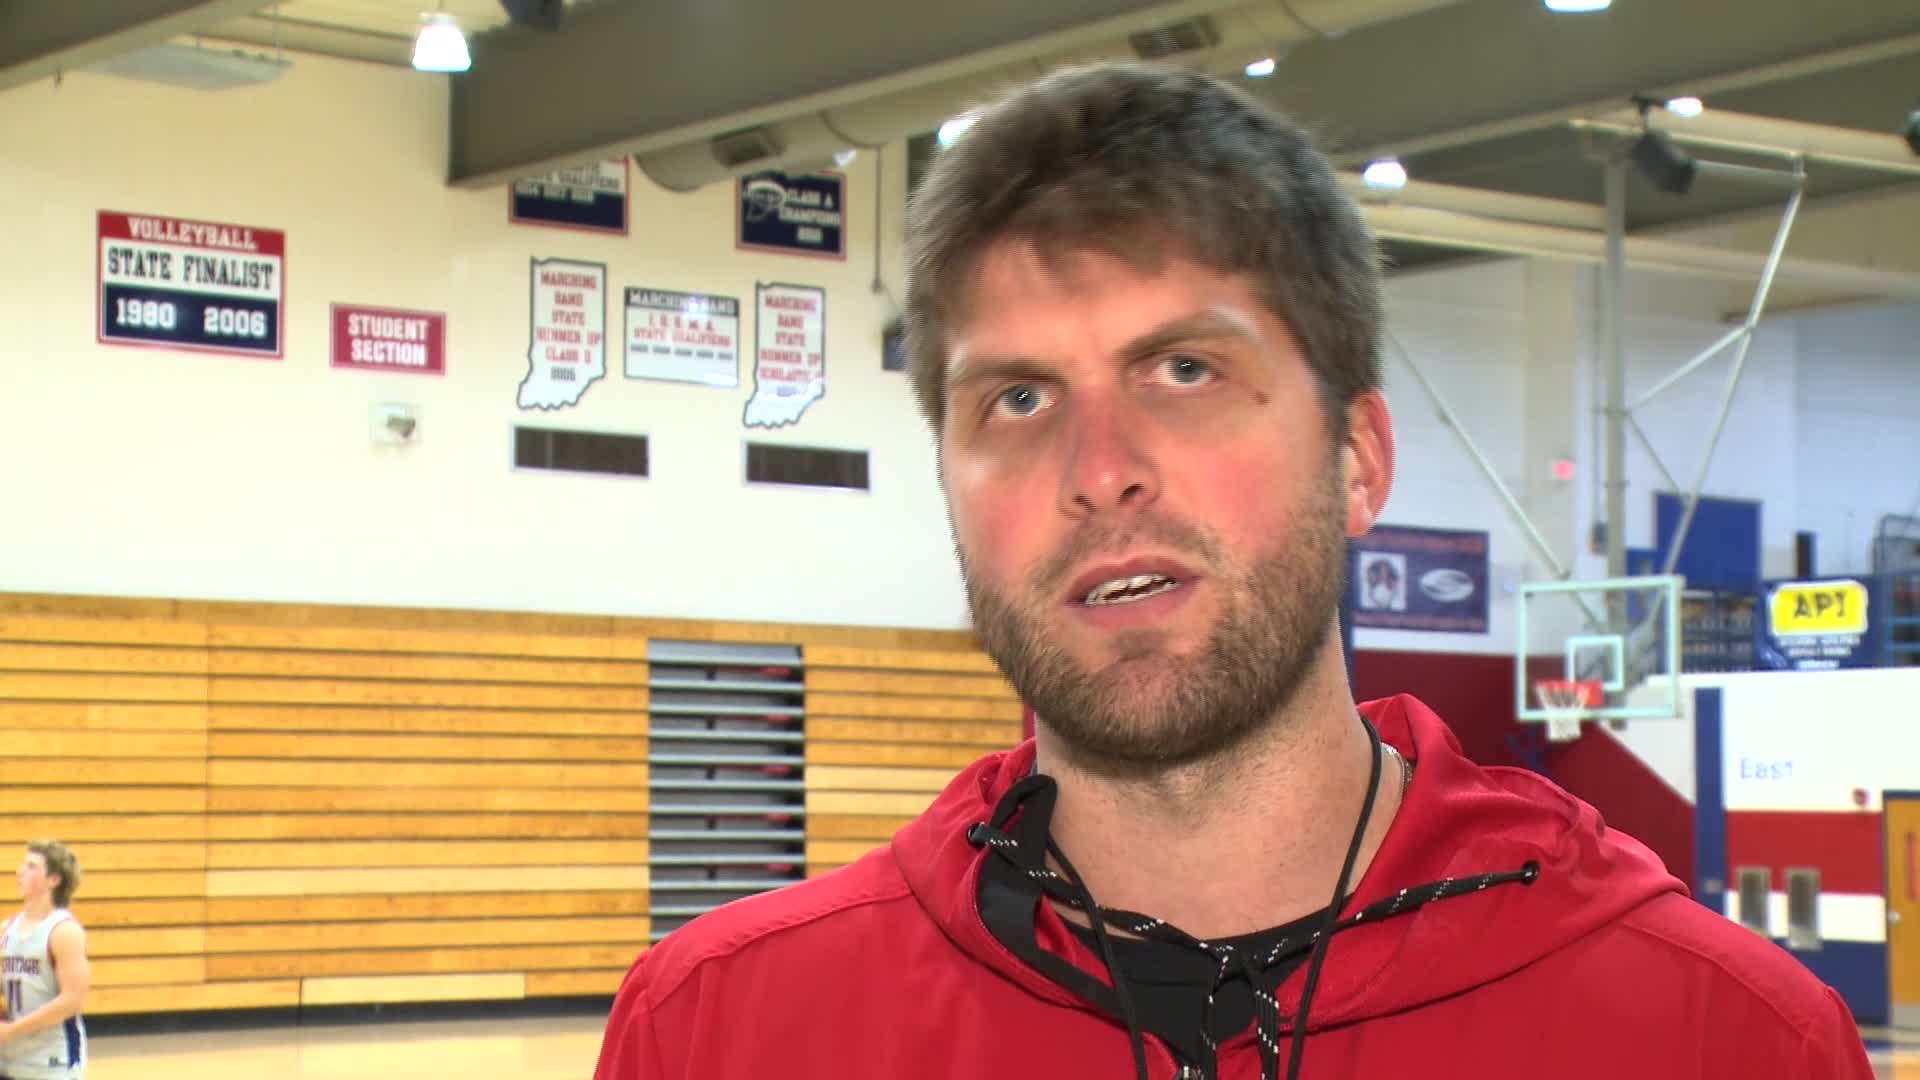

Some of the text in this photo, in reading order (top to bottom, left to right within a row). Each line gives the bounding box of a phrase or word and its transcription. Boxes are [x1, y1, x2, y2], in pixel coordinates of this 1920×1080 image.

[127, 216, 257, 250] VOLLEYBALL
[108, 247, 273, 289] STATE FINALIST
[541, 271, 598, 289] MARCHING
[554, 291, 583, 306] BAND
[116, 297, 268, 339] 1980 2006
[347, 313, 428, 341] STUDENT
[551, 309, 585, 326] STATE
[351, 338, 427, 367] SECTION
[1793, 591, 1847, 618] API
[1740, 757, 1793, 780] East
